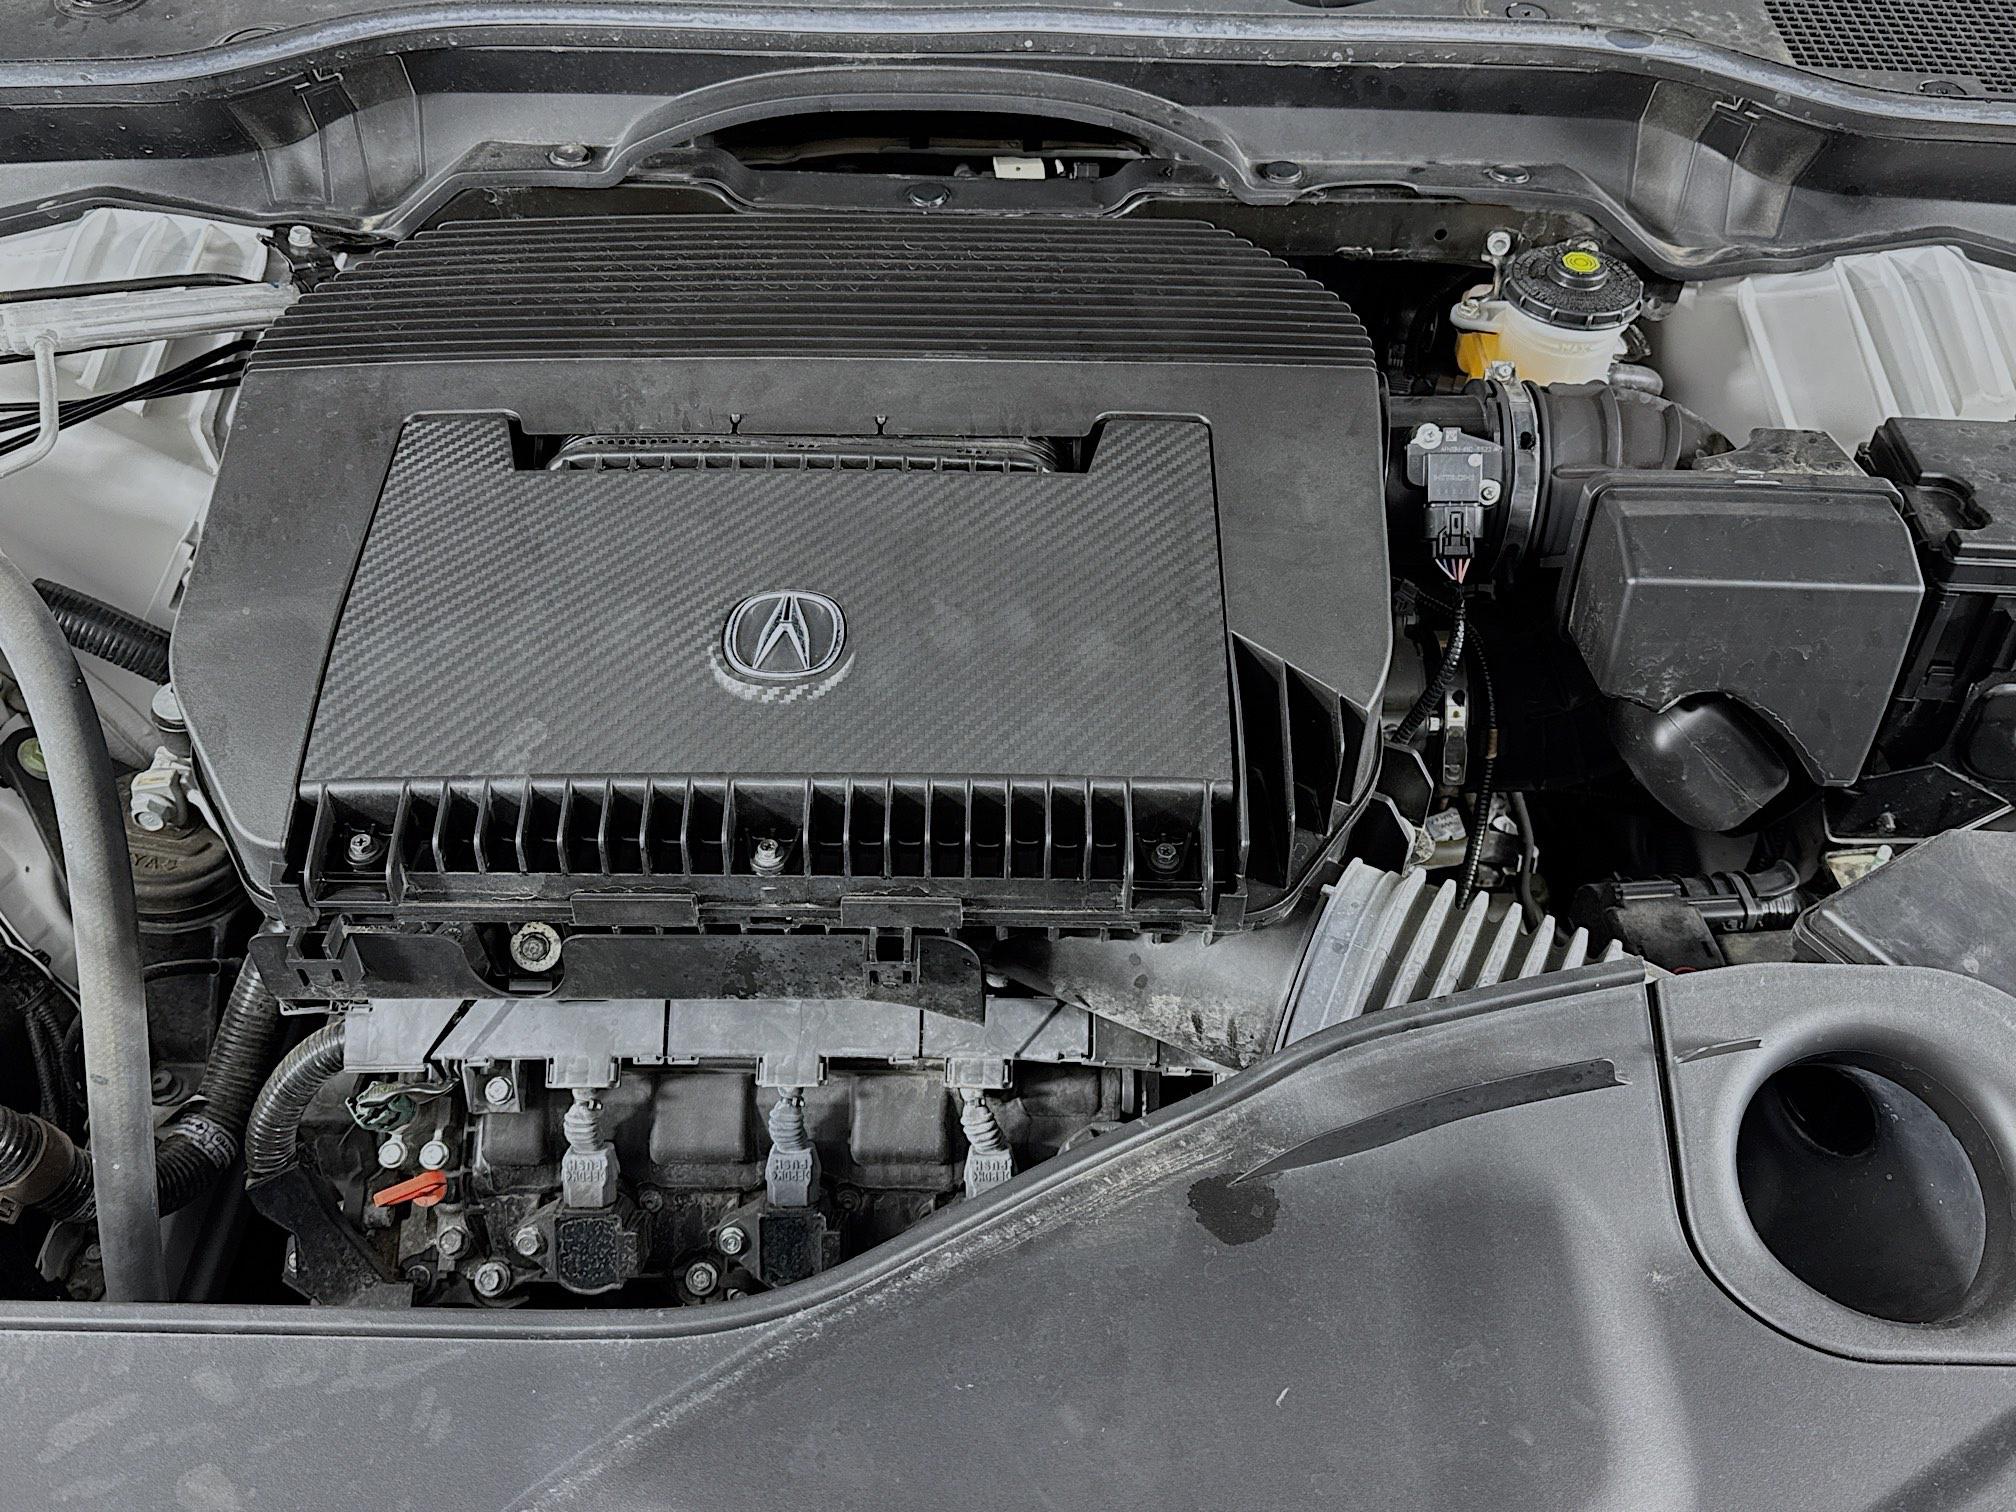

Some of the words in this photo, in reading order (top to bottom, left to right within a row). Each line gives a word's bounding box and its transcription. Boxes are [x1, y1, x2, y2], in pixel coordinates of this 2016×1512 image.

[1560, 342, 1593, 354] MAX
[569, 1159, 603, 1171] PUSH
[775, 1159, 808, 1170] PUSH
[975, 1160, 1008, 1171] PUSH
